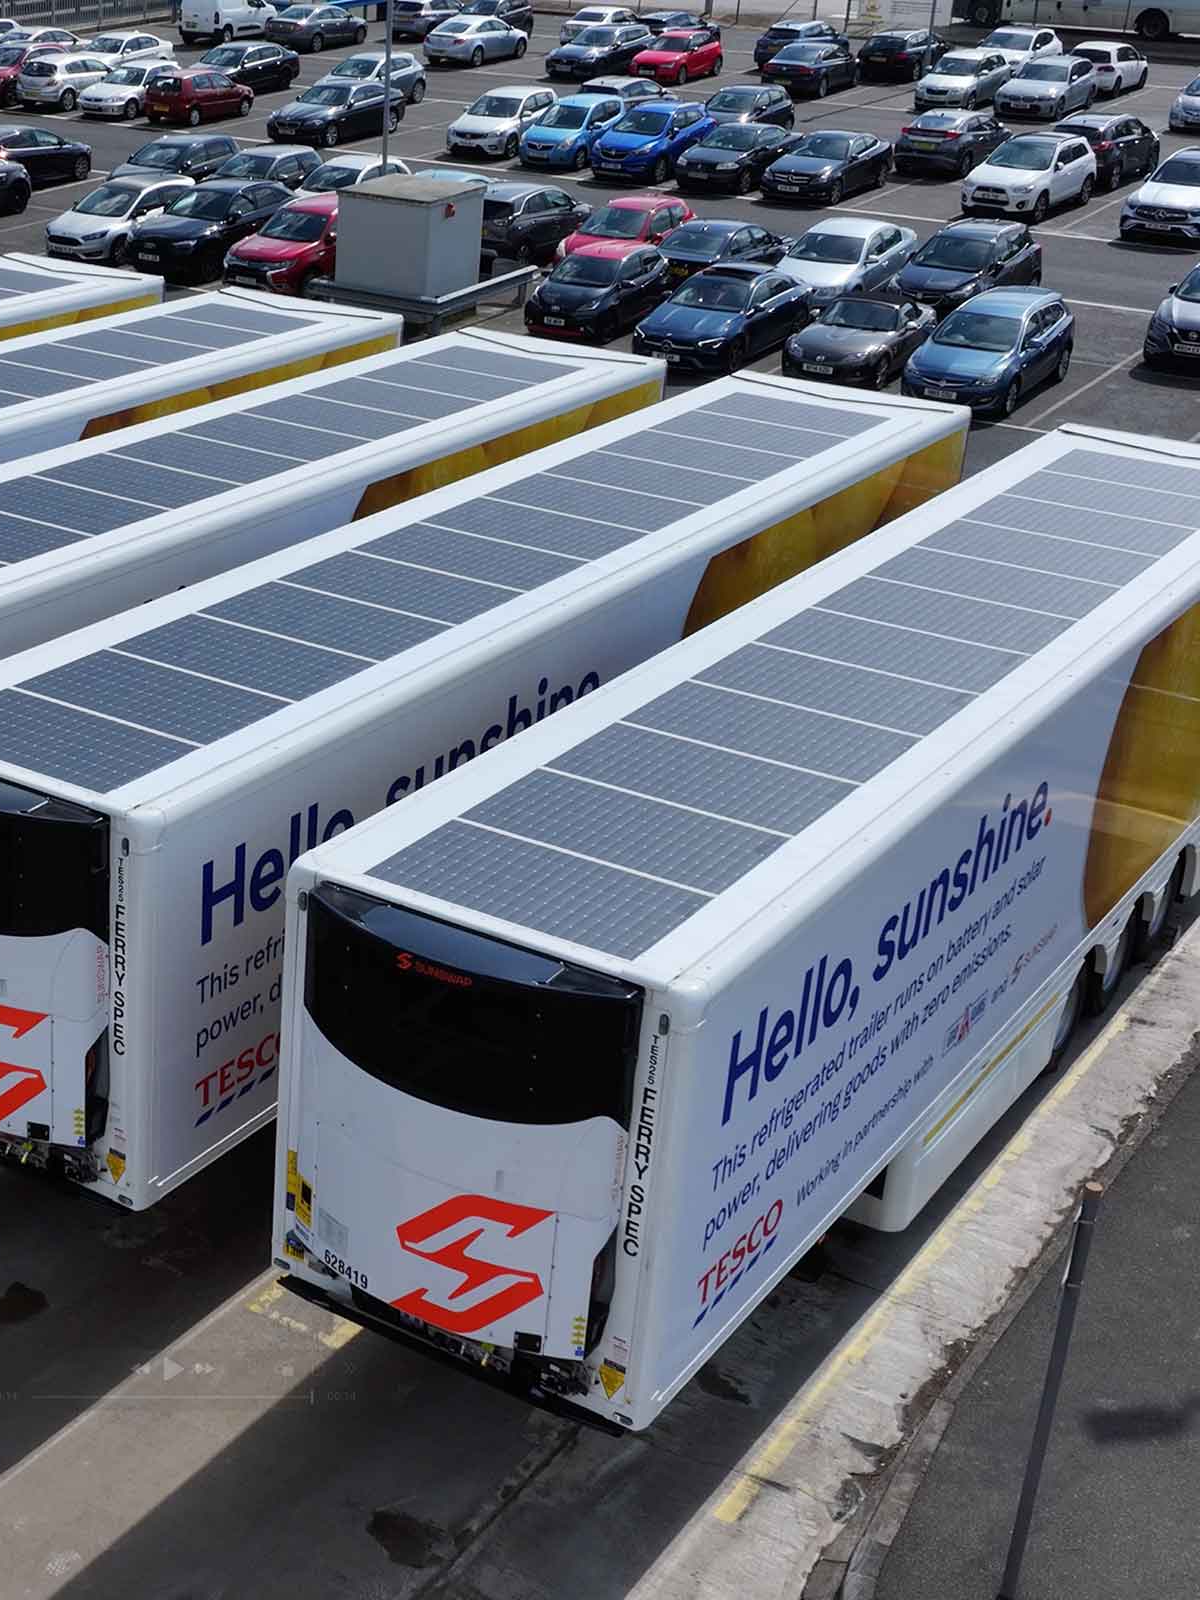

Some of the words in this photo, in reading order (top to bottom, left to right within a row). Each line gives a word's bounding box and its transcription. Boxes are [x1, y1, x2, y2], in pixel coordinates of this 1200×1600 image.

[114, 904, 126, 987] FERRY
[196, 964, 240, 1004] This
[722, 954, 861, 1127] Hello,
[872, 781, 1053, 983] sunshine.
[113, 990, 125, 1056] SPEC
[194, 992, 264, 1058] power,
[712, 1145, 747, 1192] This
[749, 1042, 847, 1160] refrigerated
[848, 1001, 892, 1060] trailer
[892, 973, 926, 1017] runs
[926, 954, 945, 984] on
[946, 908, 991, 964] battery
[991, 888, 1016, 921] and
[1016, 855, 1047, 897] solar
[633, 1087, 658, 1181] FERRY
[702, 1173, 761, 1253] power,
[764, 1086, 843, 1182] delivering
[842, 1043, 888, 1110] goods
[890, 1011, 920, 1055] with
[920, 985, 950, 1025] zero
[623, 1184, 645, 1257] SPEC
[698, 1199, 784, 1305] TESCO
[796, 1146, 841, 1208] Working
[841, 1136, 855, 1162] in
[853, 1077, 911, 1153] partnership
[913, 1055, 934, 1085] with
[324, 1249, 369, 1289] 628419
